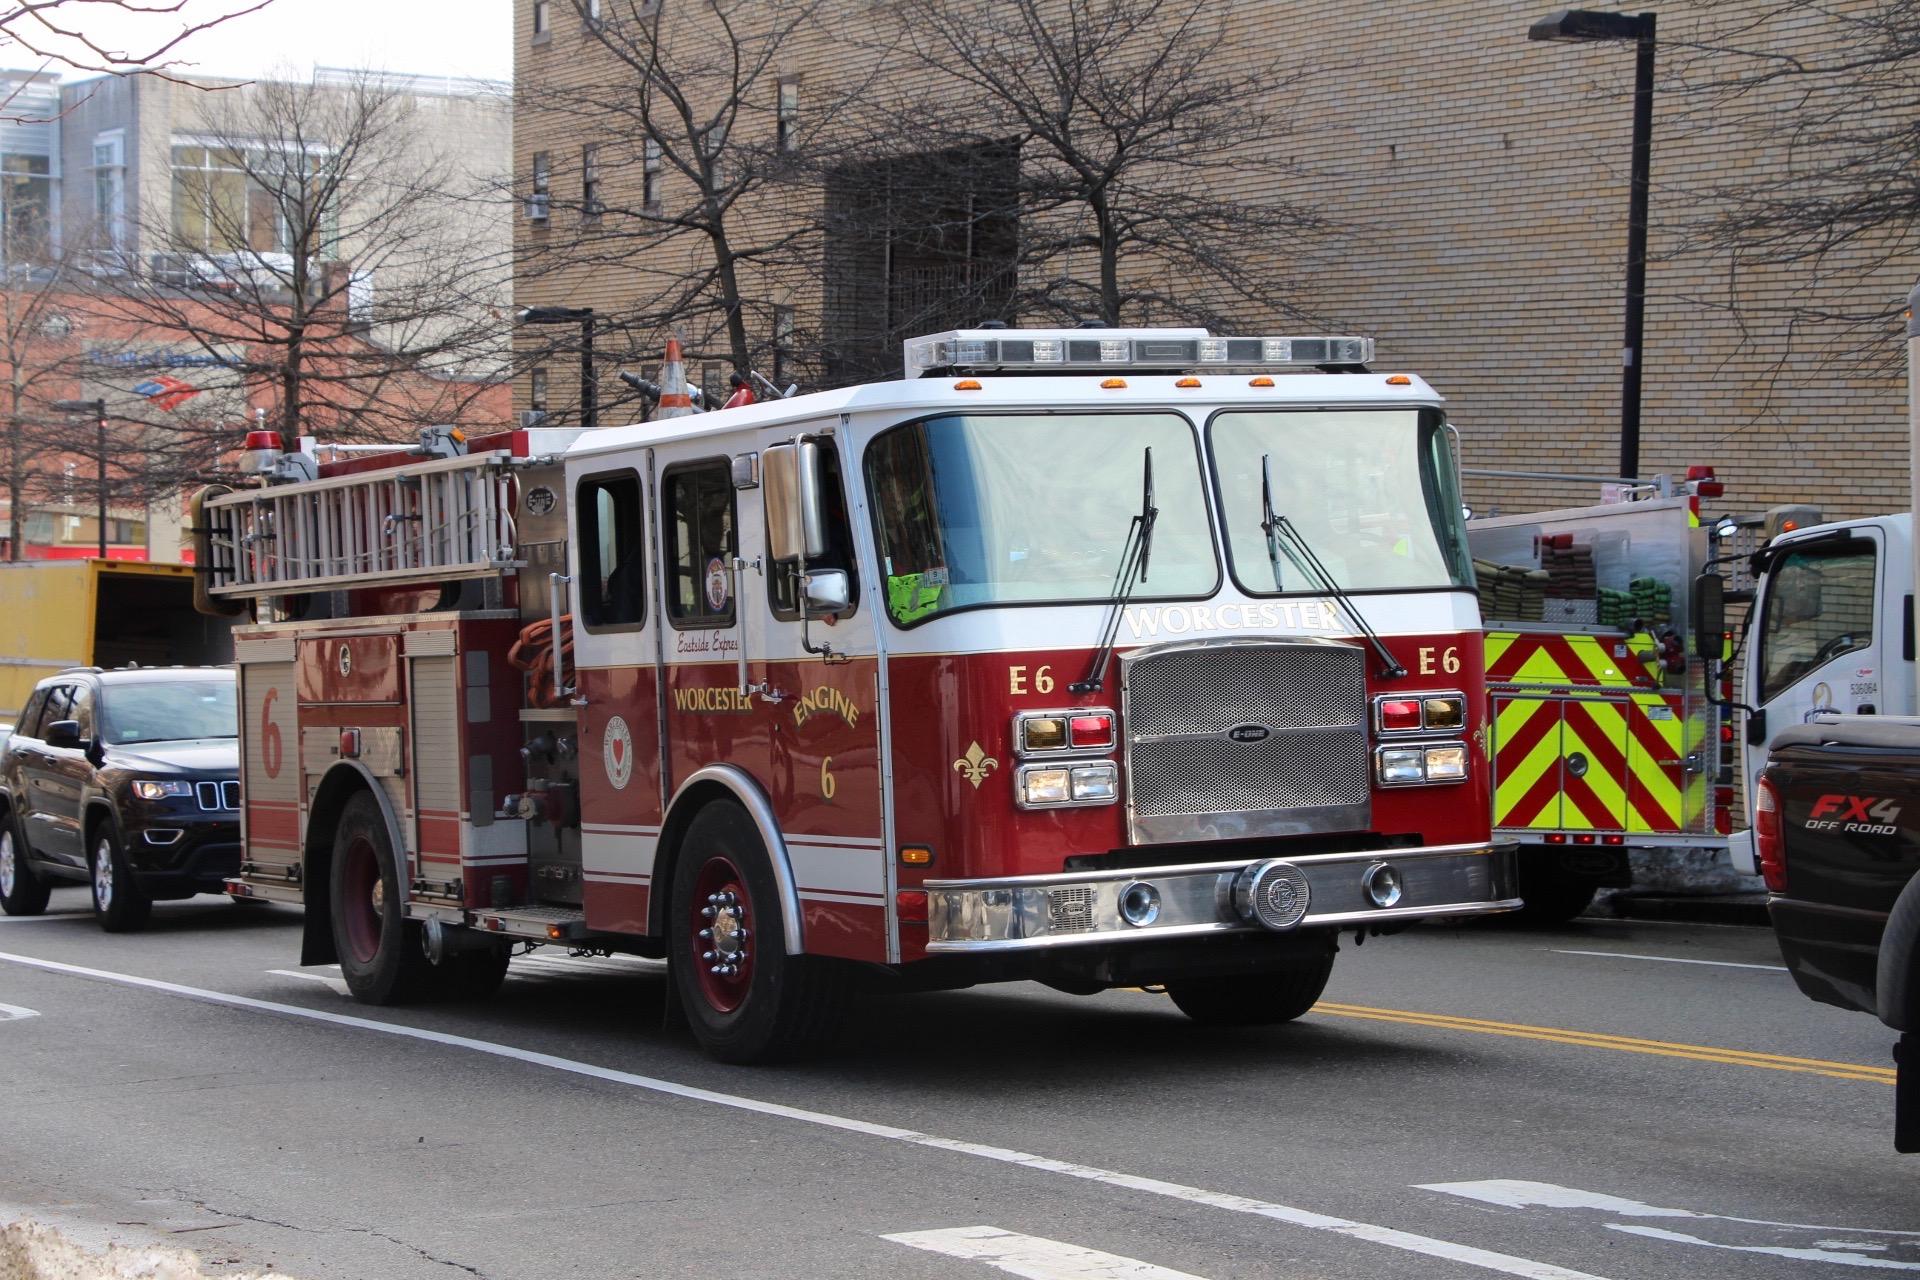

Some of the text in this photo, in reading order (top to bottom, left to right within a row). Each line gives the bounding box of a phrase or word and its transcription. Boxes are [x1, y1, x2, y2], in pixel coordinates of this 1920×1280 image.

[1124, 601, 1344, 638] WORCESTER
[677, 630, 738, 659] Eastside Expres
[1419, 646, 1460, 674] E 6
[1009, 665, 1054, 695] E 6
[1850, 682, 1877, 695] 536064
[674, 687, 753, 710] WORCESTER
[792, 685, 859, 729] ENGINE
[262, 687, 282, 779] 6
[1233, 729, 1266, 739] E-ONE
[822, 756, 836, 799] 6
[1809, 794, 1902, 824] FX4
[1805, 819, 1897, 835] OFF ROAD
